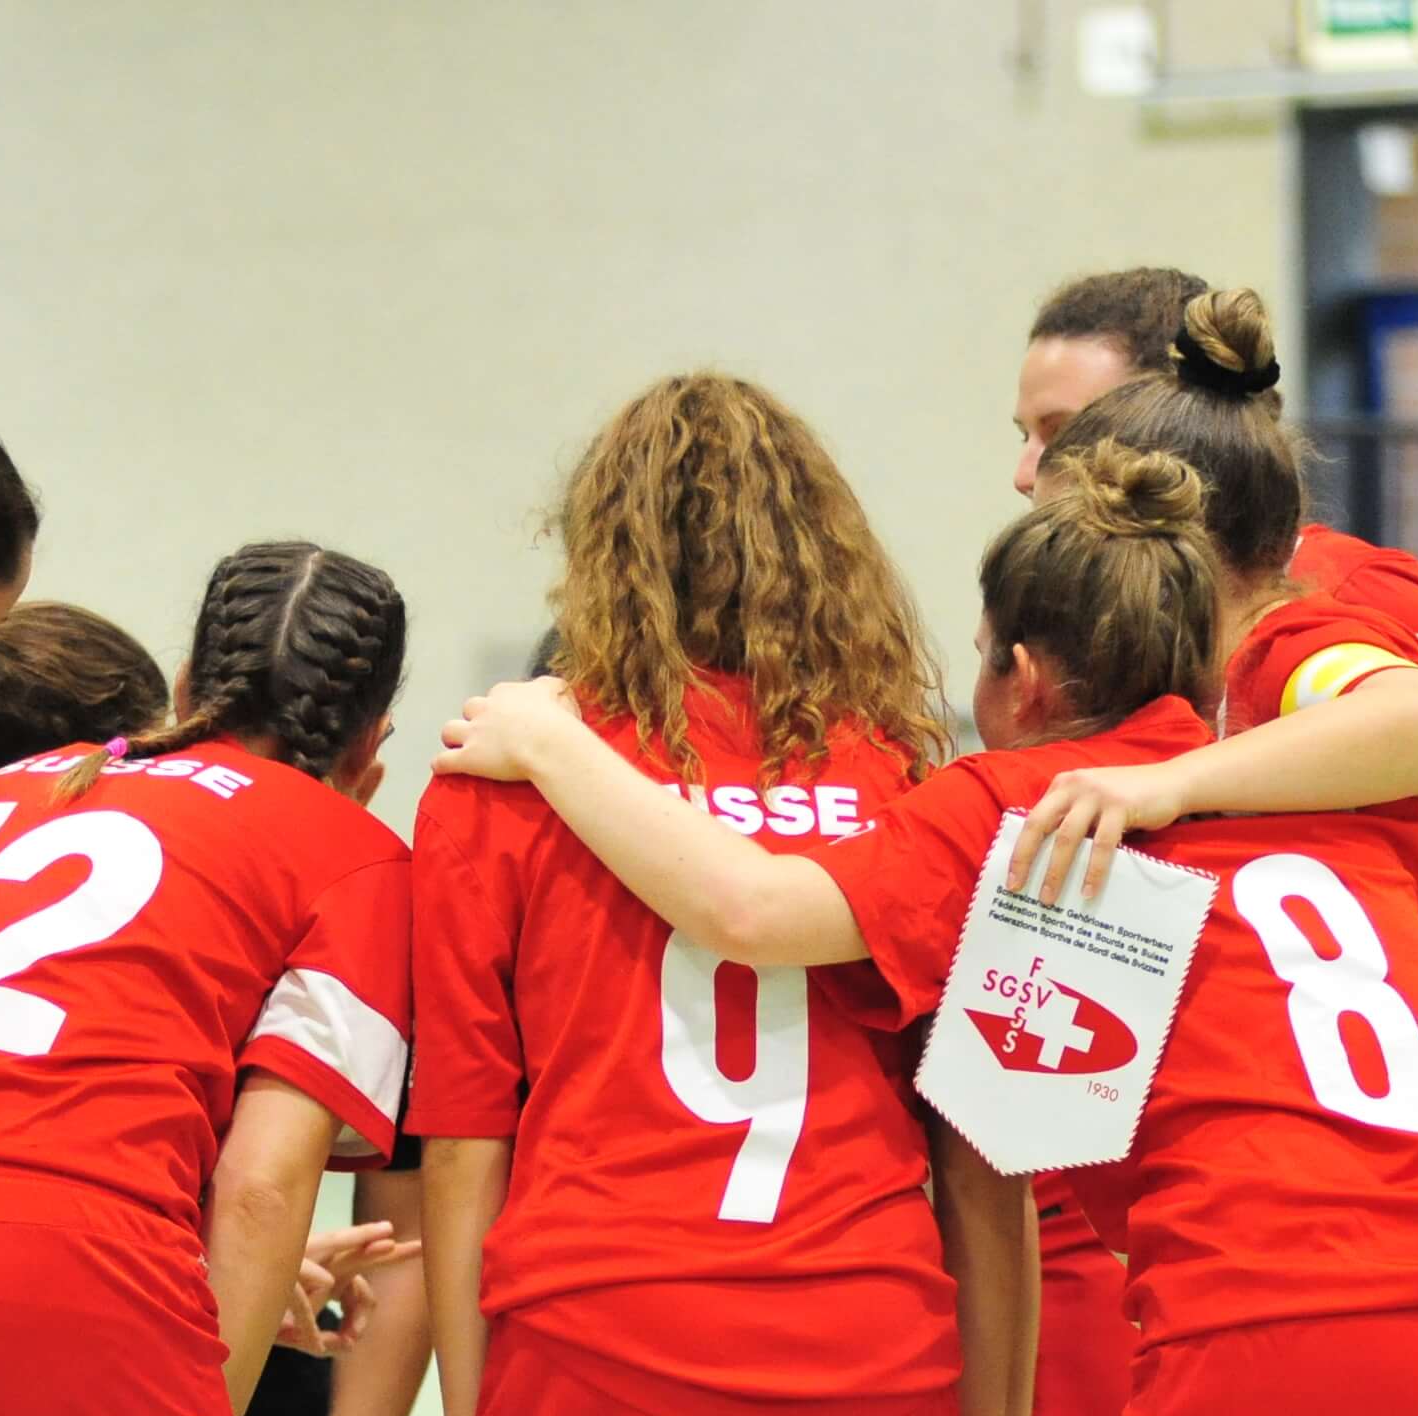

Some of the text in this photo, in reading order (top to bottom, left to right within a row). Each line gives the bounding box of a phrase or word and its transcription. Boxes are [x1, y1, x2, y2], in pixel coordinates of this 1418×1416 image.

[1076, 926, 1093, 939] des
[1094, 932, 1126, 948] Sourds
[1140, 948, 1170, 963] Suisse
[1116, 926, 1174, 952] Sportverband
[983, 969, 1053, 1009] SGSV
[661, 928, 809, 1223] 9
[1087, 1080, 1119, 1102] 1930
